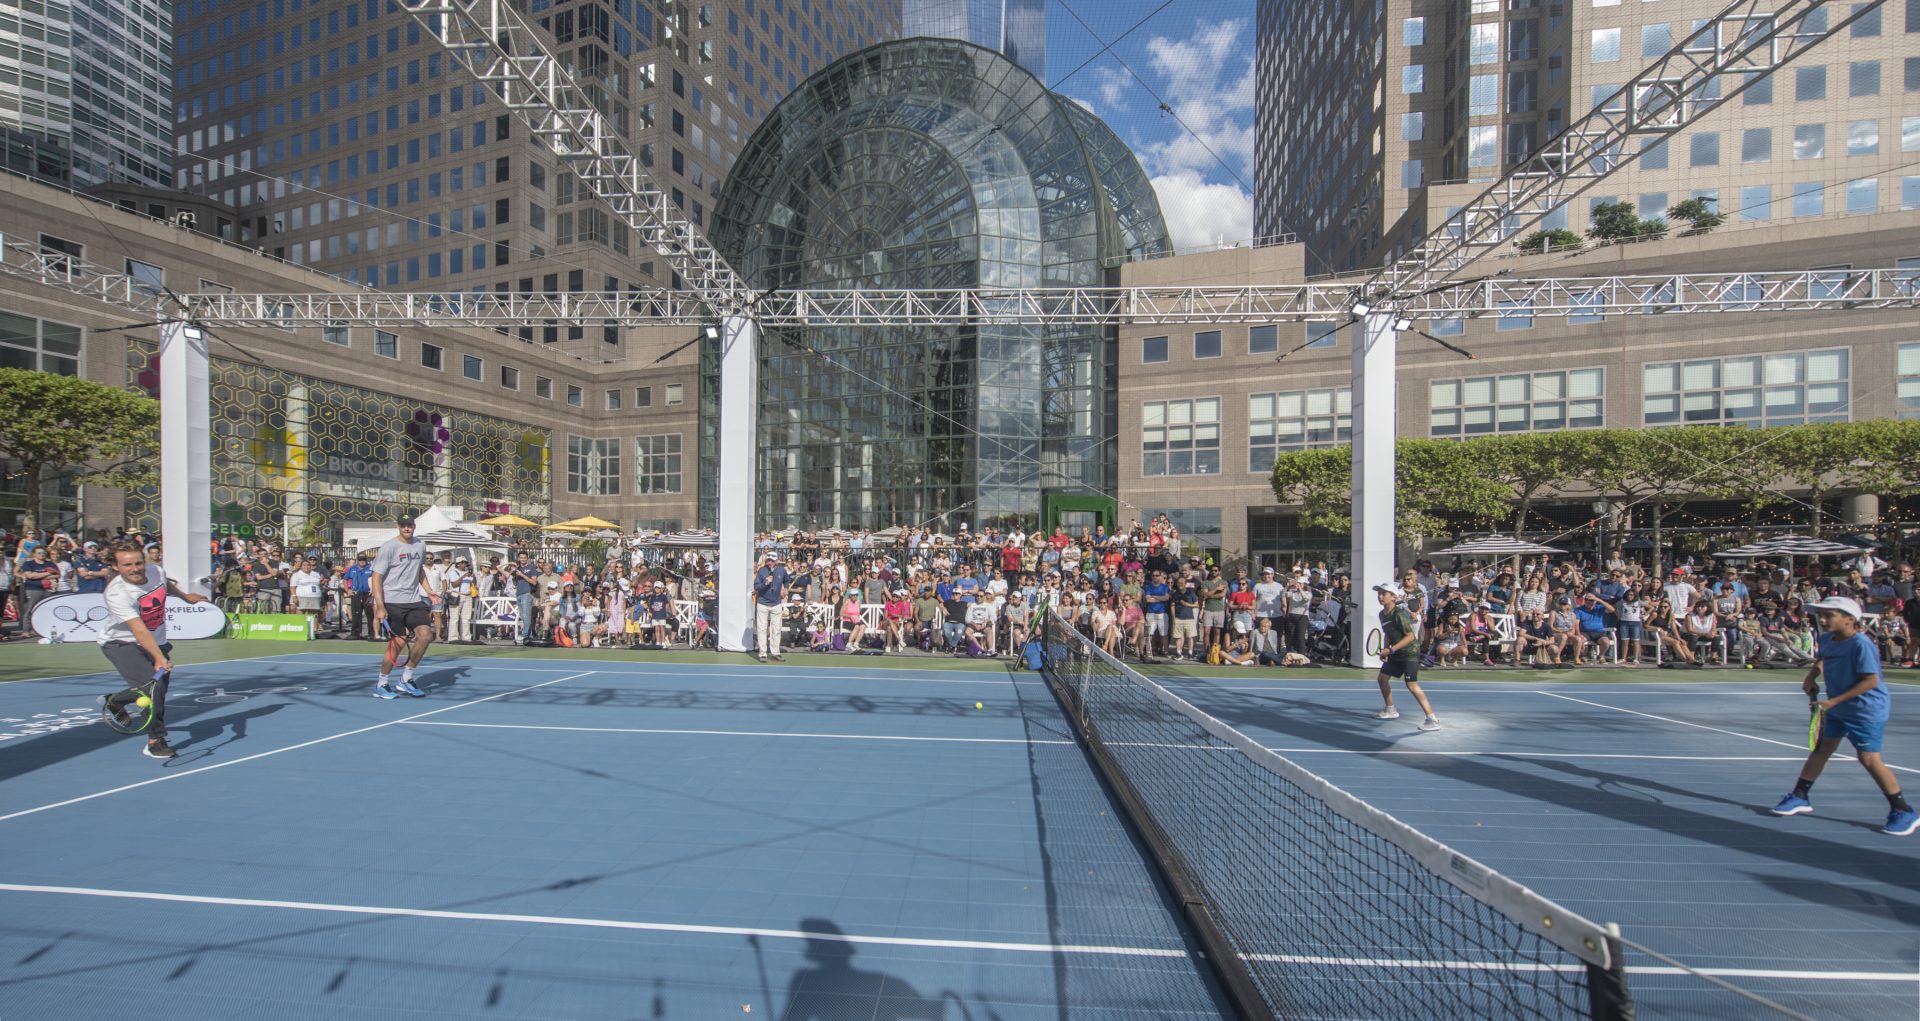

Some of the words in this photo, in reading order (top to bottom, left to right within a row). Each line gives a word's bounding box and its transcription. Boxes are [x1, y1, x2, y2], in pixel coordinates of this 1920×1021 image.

[399, 551, 421, 563] FILA
[250, 622, 274, 632] prince
[279, 623, 304, 633] prince
